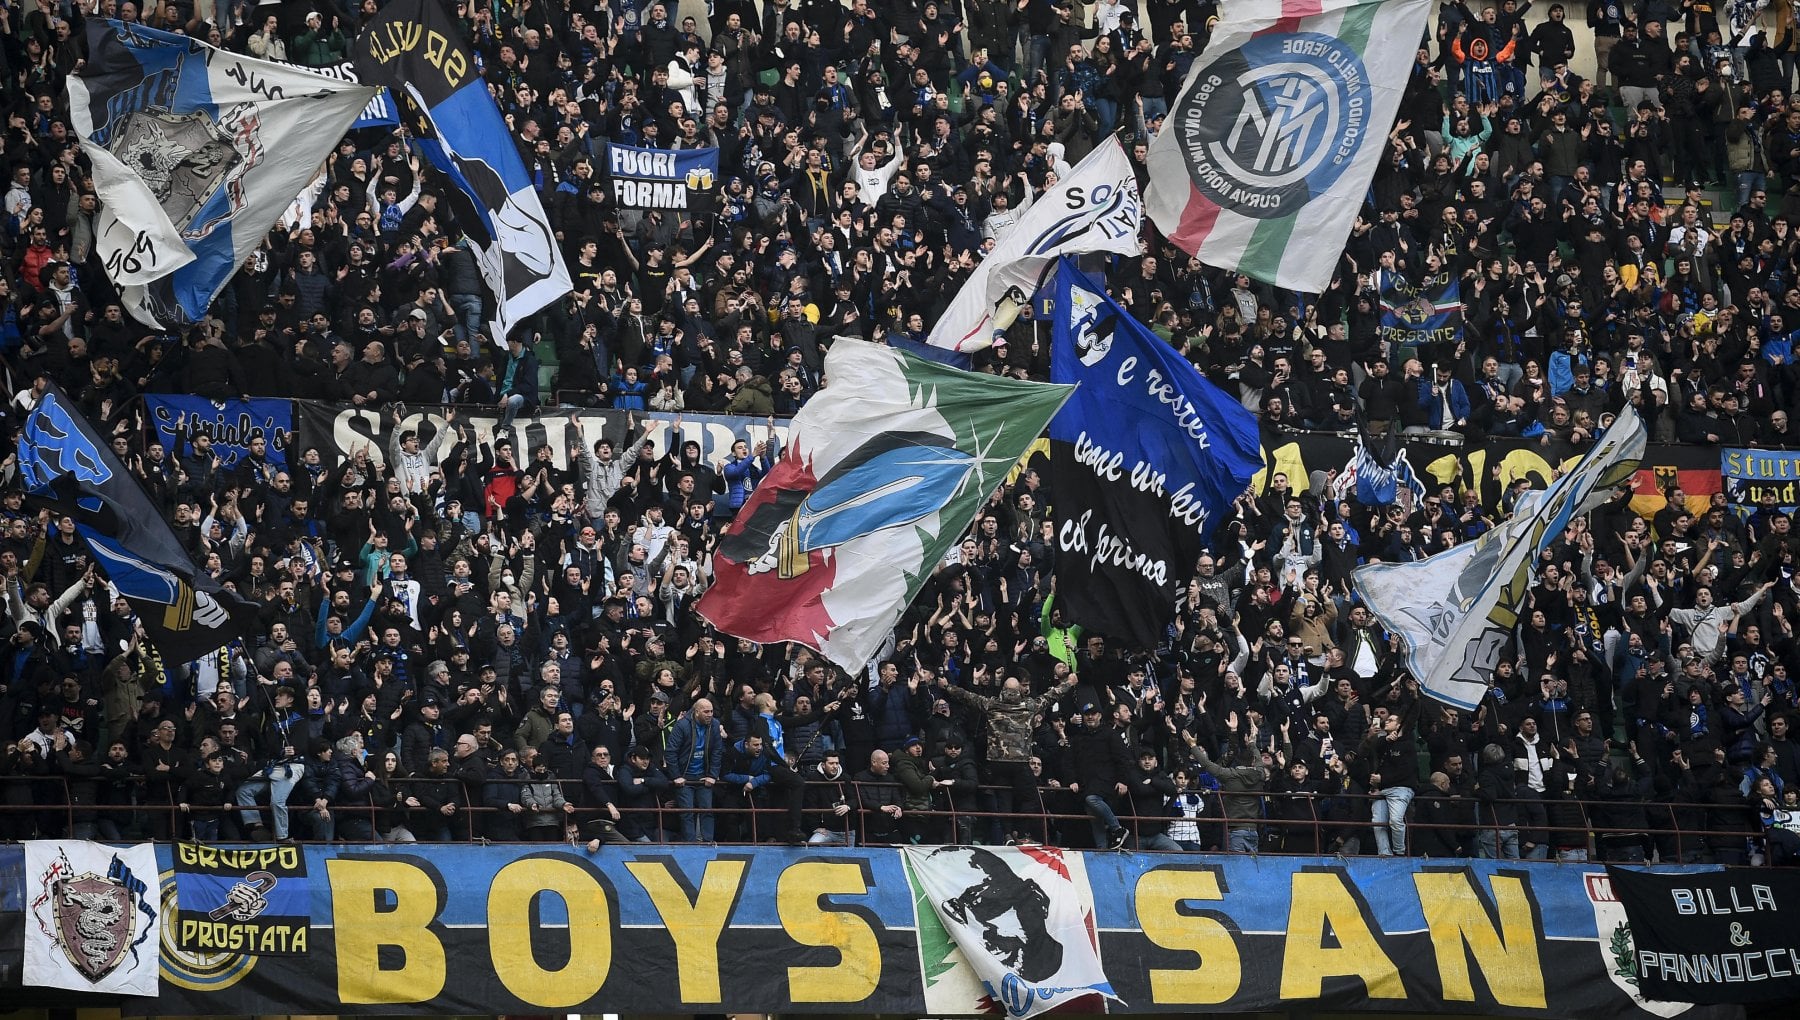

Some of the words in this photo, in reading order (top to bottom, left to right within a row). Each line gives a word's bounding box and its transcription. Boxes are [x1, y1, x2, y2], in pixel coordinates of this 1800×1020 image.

[611, 146, 677, 177] FUORI
[613, 179, 688, 209] FORMA
[1382, 326, 1455, 342] PRESENTE
[1117, 356, 1138, 387] e
[178, 842, 299, 871] GRUPPO
[1671, 884, 1778, 916] BILLA
[181, 919, 308, 953] PROSTATA
[326, 856, 882, 1008] BOYS
[1135, 869, 1549, 1010] SAN
[1729, 921, 1753, 947] &
